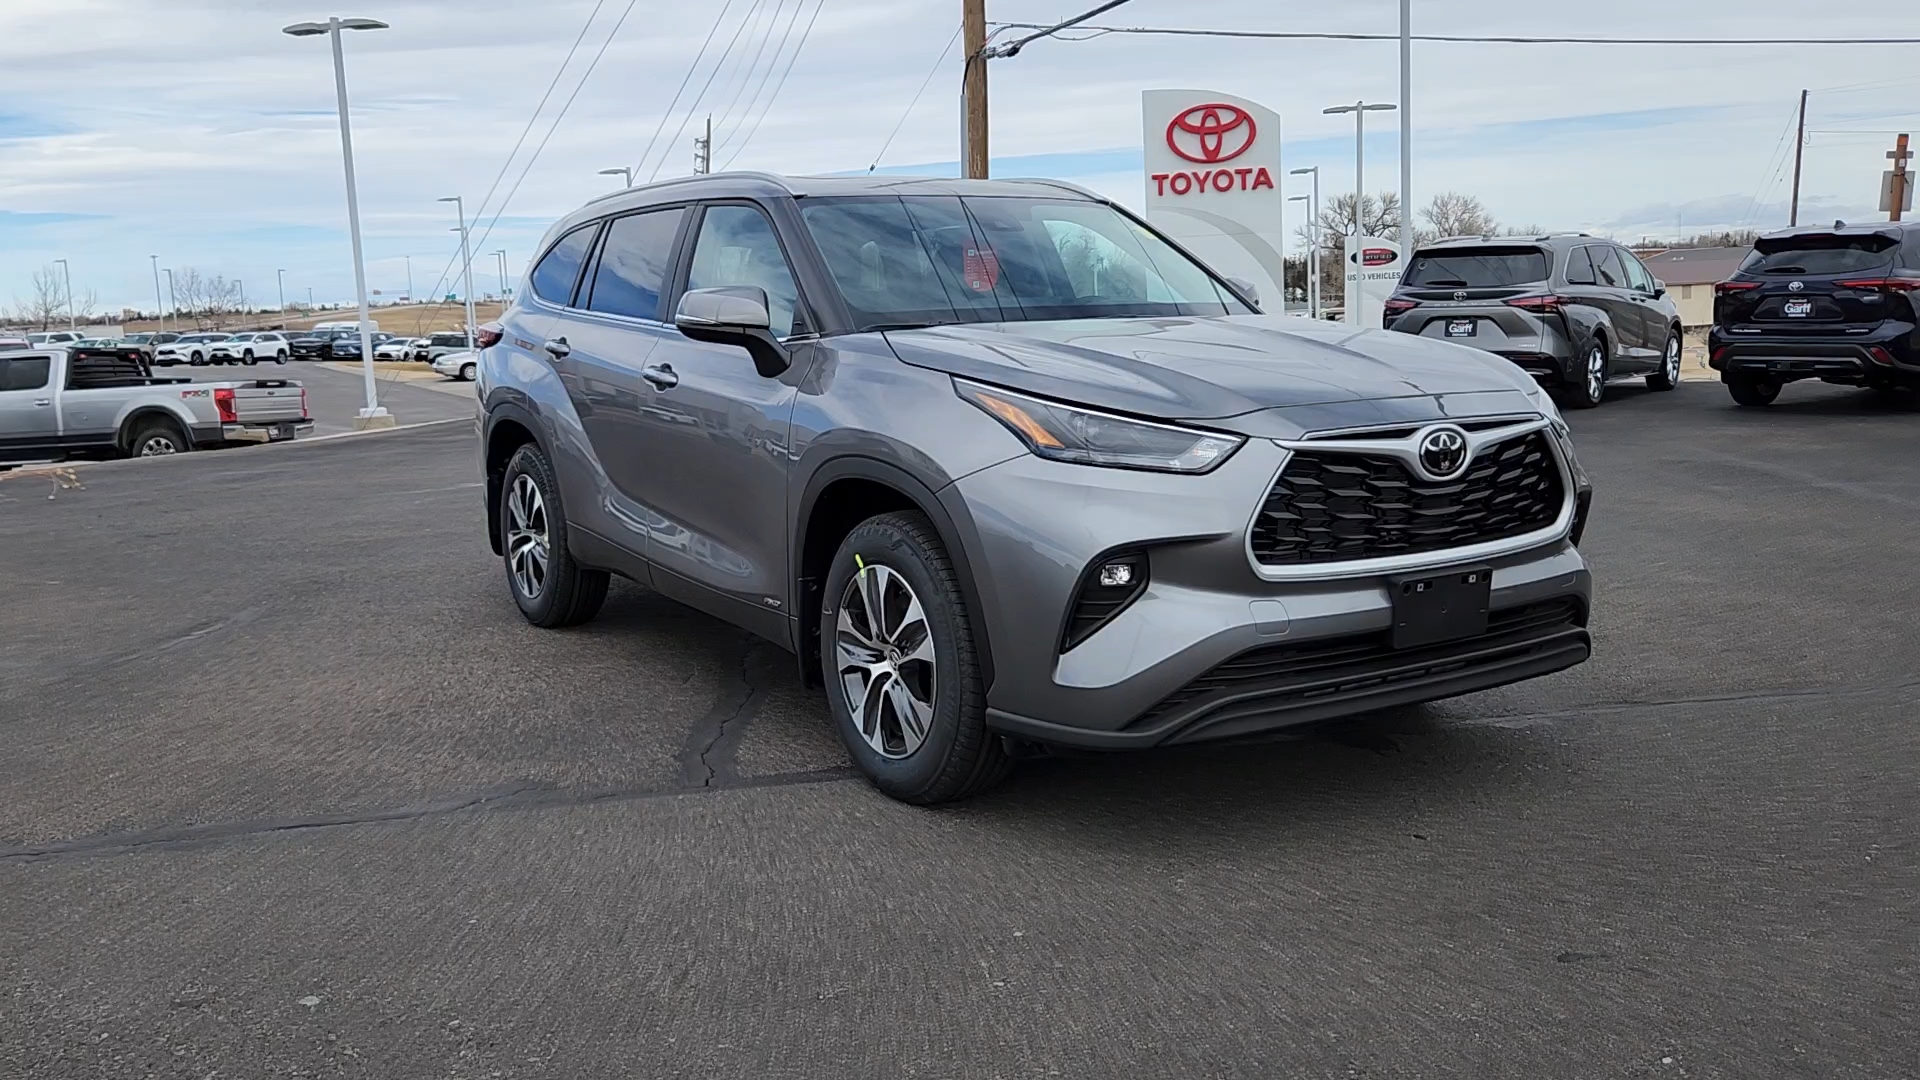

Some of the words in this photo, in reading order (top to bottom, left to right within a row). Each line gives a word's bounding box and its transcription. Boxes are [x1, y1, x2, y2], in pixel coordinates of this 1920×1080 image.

[1151, 167, 1274, 196] TOYOTA
[1347, 273, 1366, 281] USD
[1367, 271, 1401, 280] VEHICLES
[1783, 303, 1812, 314] Garff
[1448, 323, 1473, 333] Garff
